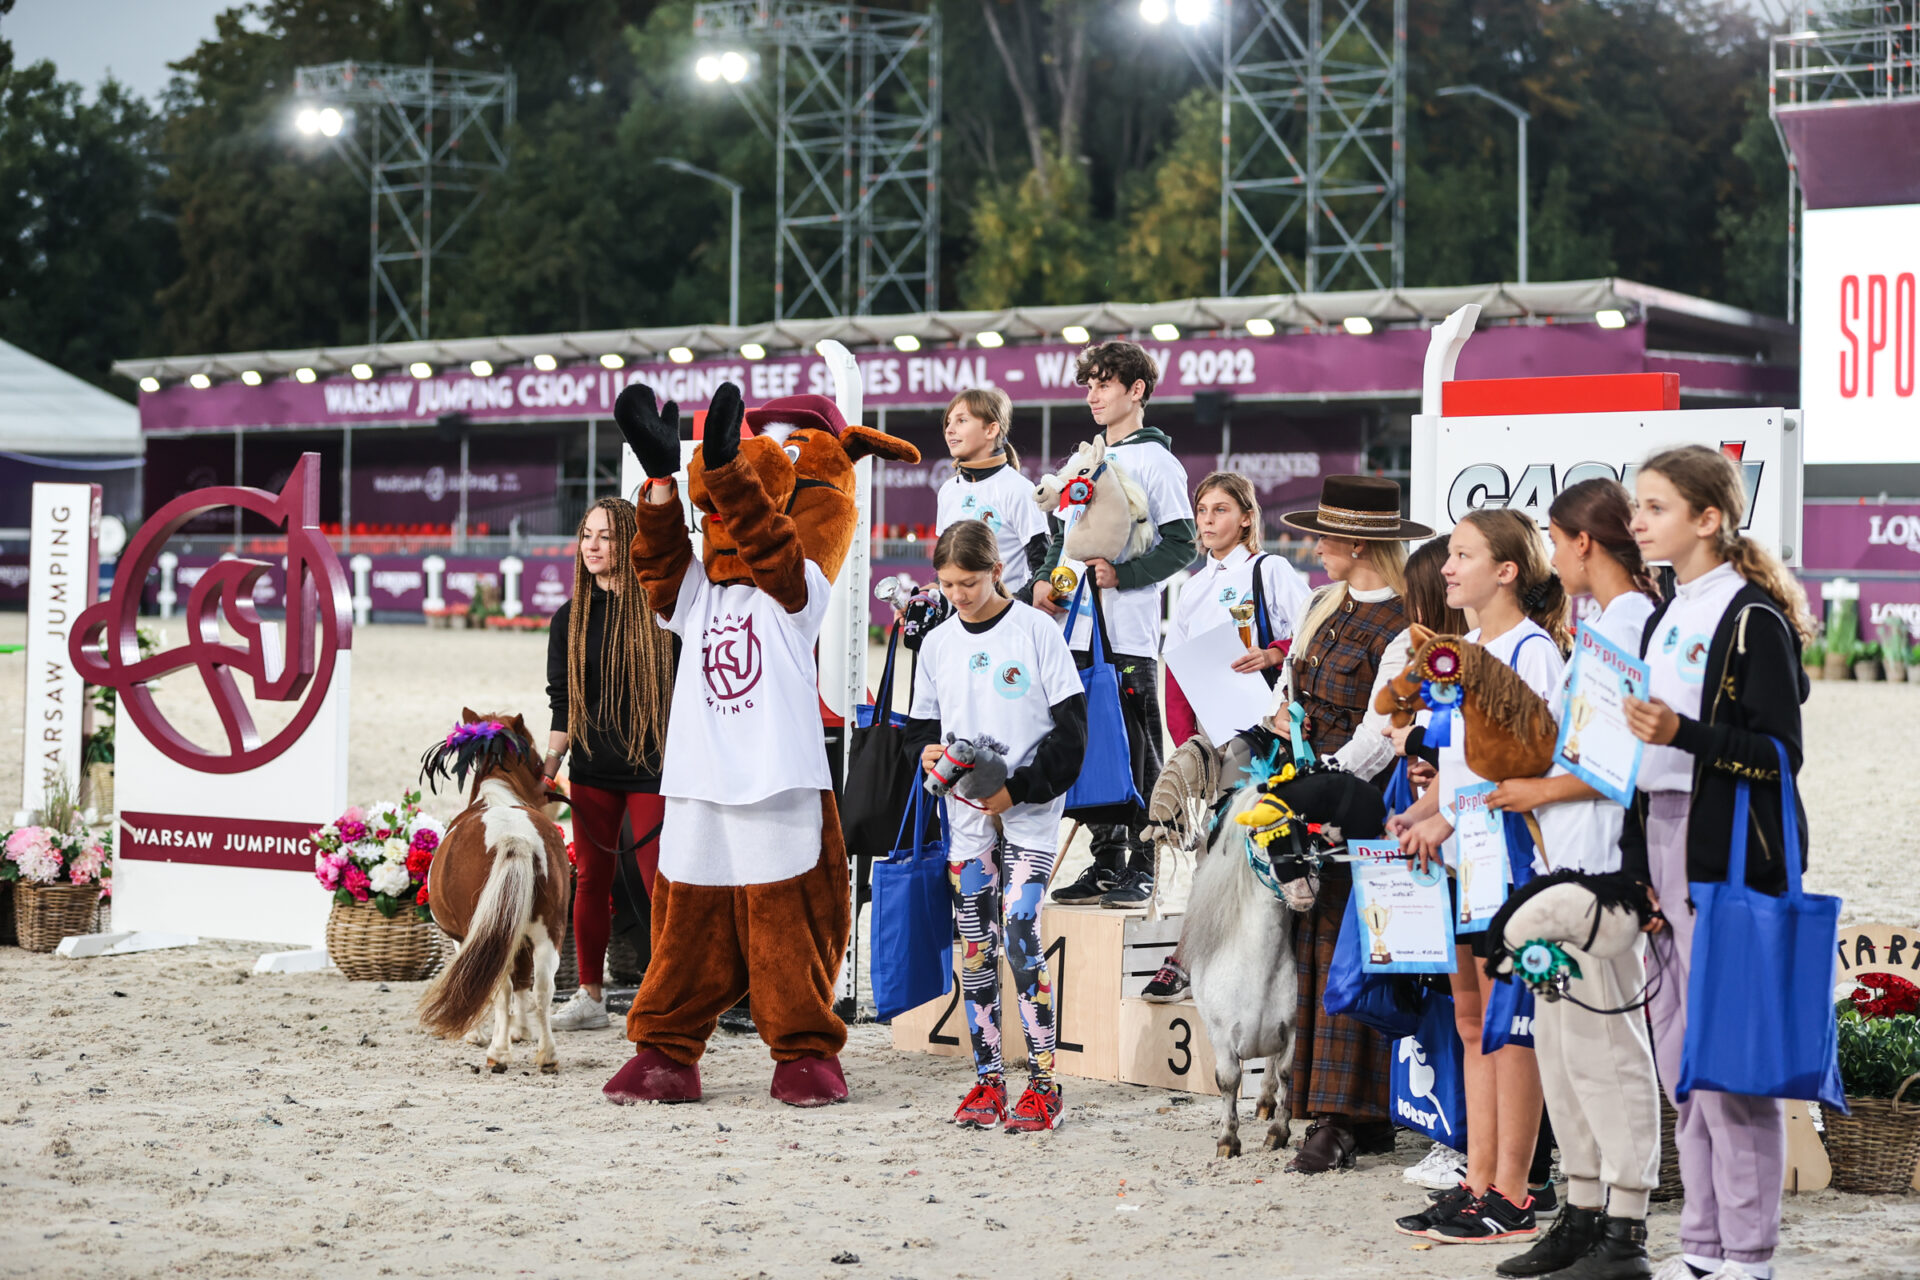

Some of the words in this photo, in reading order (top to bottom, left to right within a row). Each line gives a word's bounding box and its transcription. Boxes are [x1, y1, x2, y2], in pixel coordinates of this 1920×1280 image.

[1839, 272, 1916, 399] SPO
[324, 382, 413, 414] WARSAW
[416, 377, 513, 416] JUMPING
[751, 361, 802, 398] EEF
[808, 360, 901, 396] SEIES
[907, 355, 996, 393] FINAL
[1035, 347, 1170, 389] WAW
[1179, 347, 1256, 386] 2022
[1447, 461, 1640, 531] CA
[47, 506, 70, 640] JUMPING
[1582, 631, 1642, 684] Dyplom
[43, 661, 64, 789] WARSAW
[1458, 790, 1489, 812] Dyplo
[133, 827, 213, 849] WARSAW
[223, 833, 311, 856] JUMPING
[1358, 846, 1405, 863] Dypl
[928, 969, 960, 1046] 2
[1167, 1017, 1192, 1075] 3
